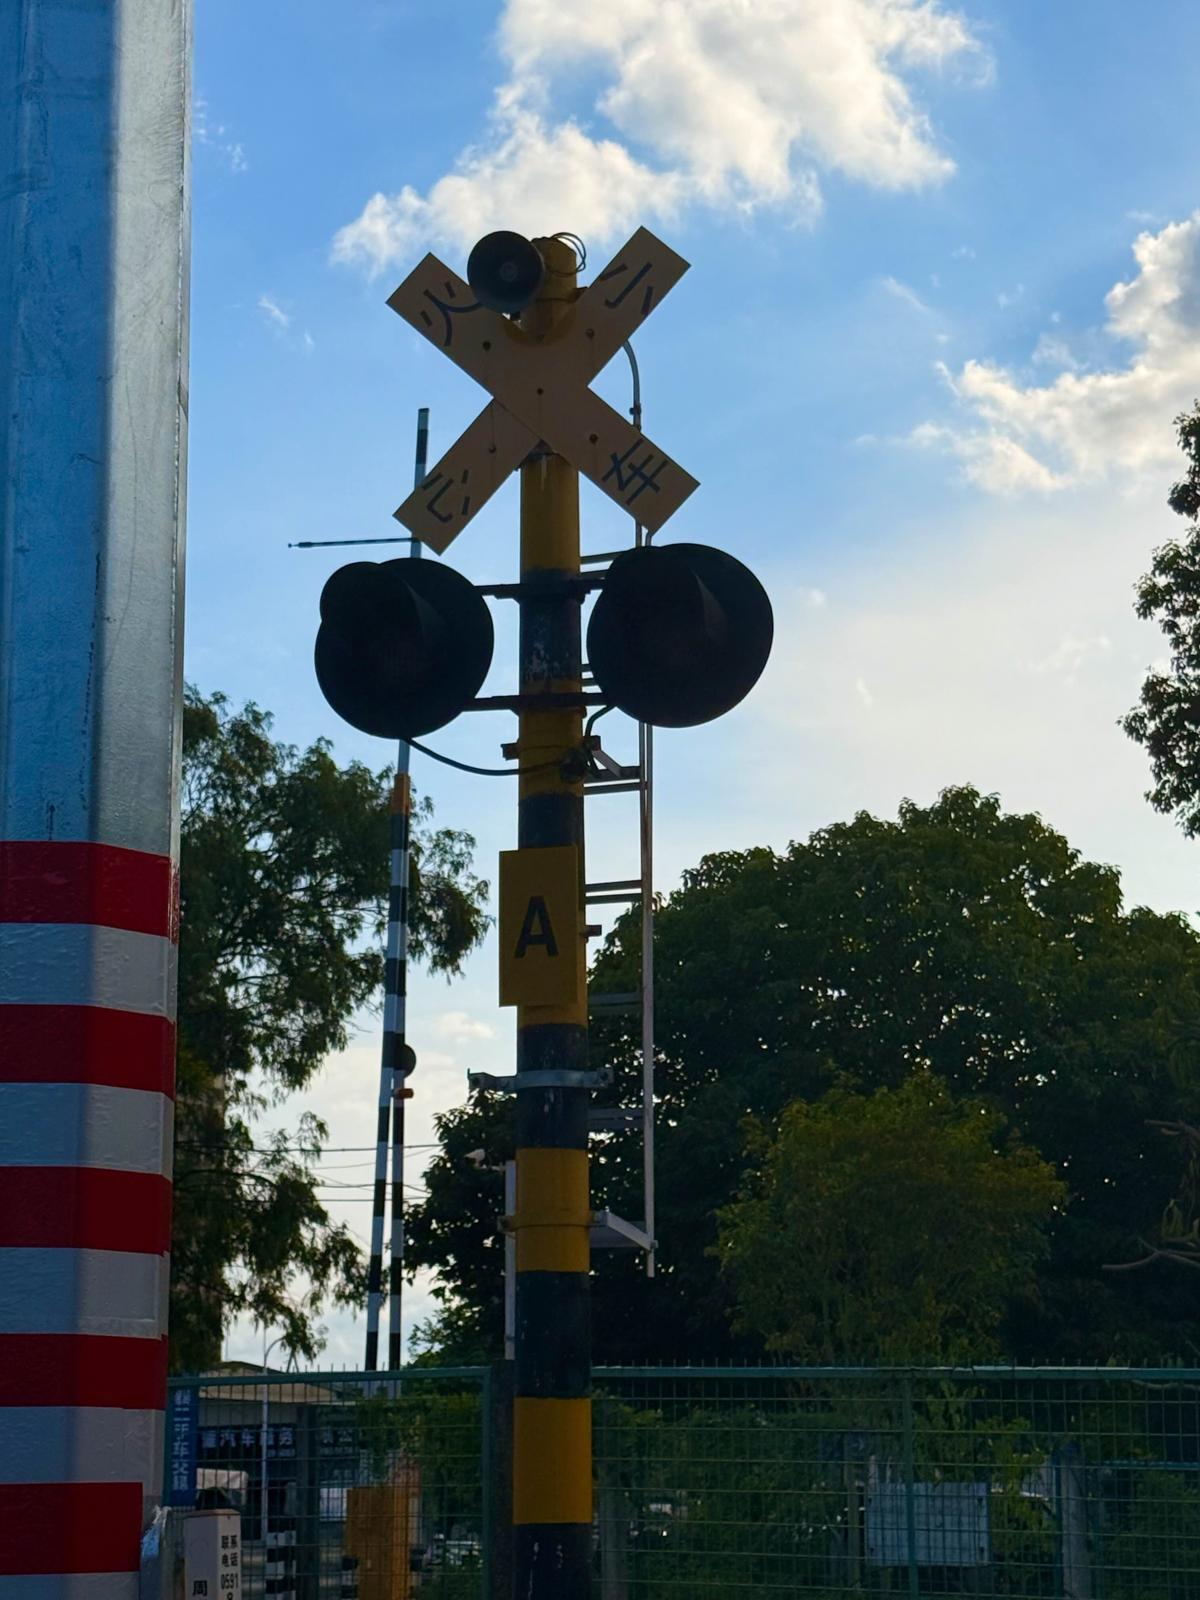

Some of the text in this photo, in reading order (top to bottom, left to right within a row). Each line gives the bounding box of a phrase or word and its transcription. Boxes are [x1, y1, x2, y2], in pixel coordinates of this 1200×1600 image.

[420, 281, 668, 506] 火 车
[422, 262, 653, 524] 小 心
[514, 895, 559, 959] A
[221, 1534, 238, 1550] 联系
[221, 1552, 238, 1567] 电话
[221, 1572, 239, 1590] 0591
